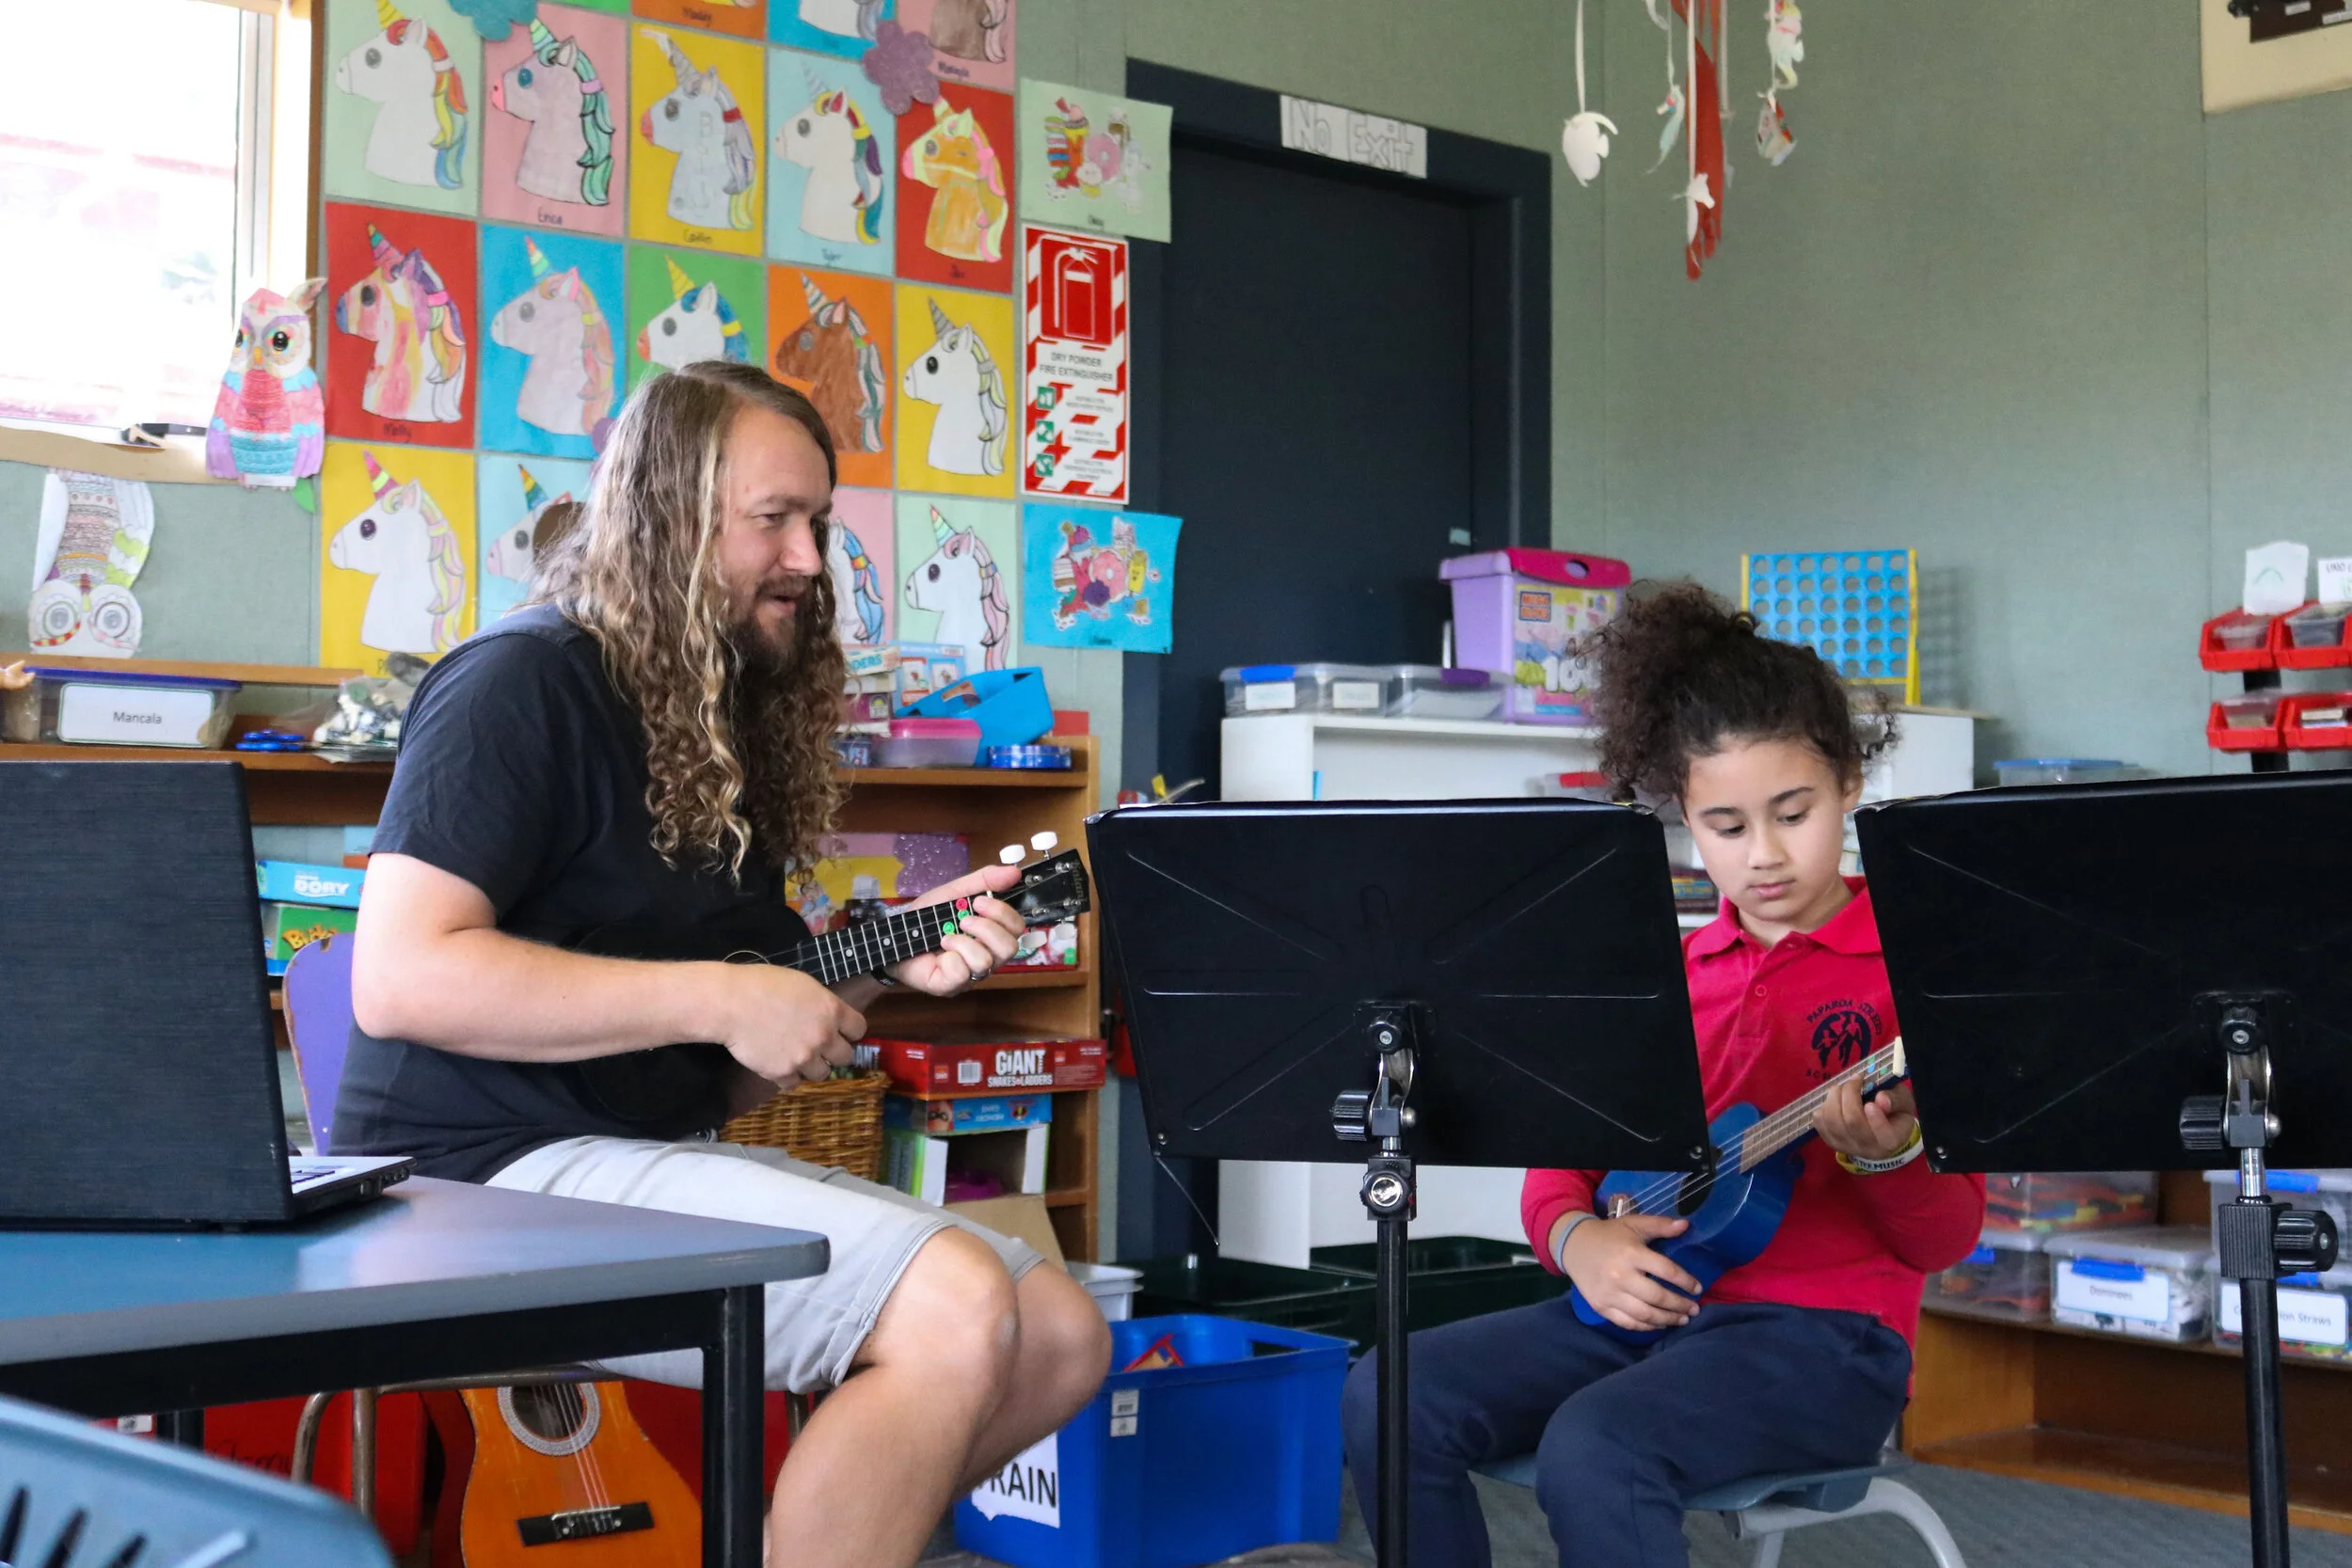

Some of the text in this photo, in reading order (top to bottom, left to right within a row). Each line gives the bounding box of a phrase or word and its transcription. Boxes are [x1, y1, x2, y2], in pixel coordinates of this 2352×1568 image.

[1051, 352, 1102, 368] DRY POWDER
[1040, 364, 1113, 382] FIRE EXTINGUISHER
[113, 711, 162, 724] Mancala
[294, 879, 350, 896] DORY
[1806, 999, 1852, 1023] PAPAROA
[1873, 1157, 1905, 1170] MUSIC
[2298, 1313, 2331, 1325] Straws
[988, 1463, 1057, 1509] RAIN
